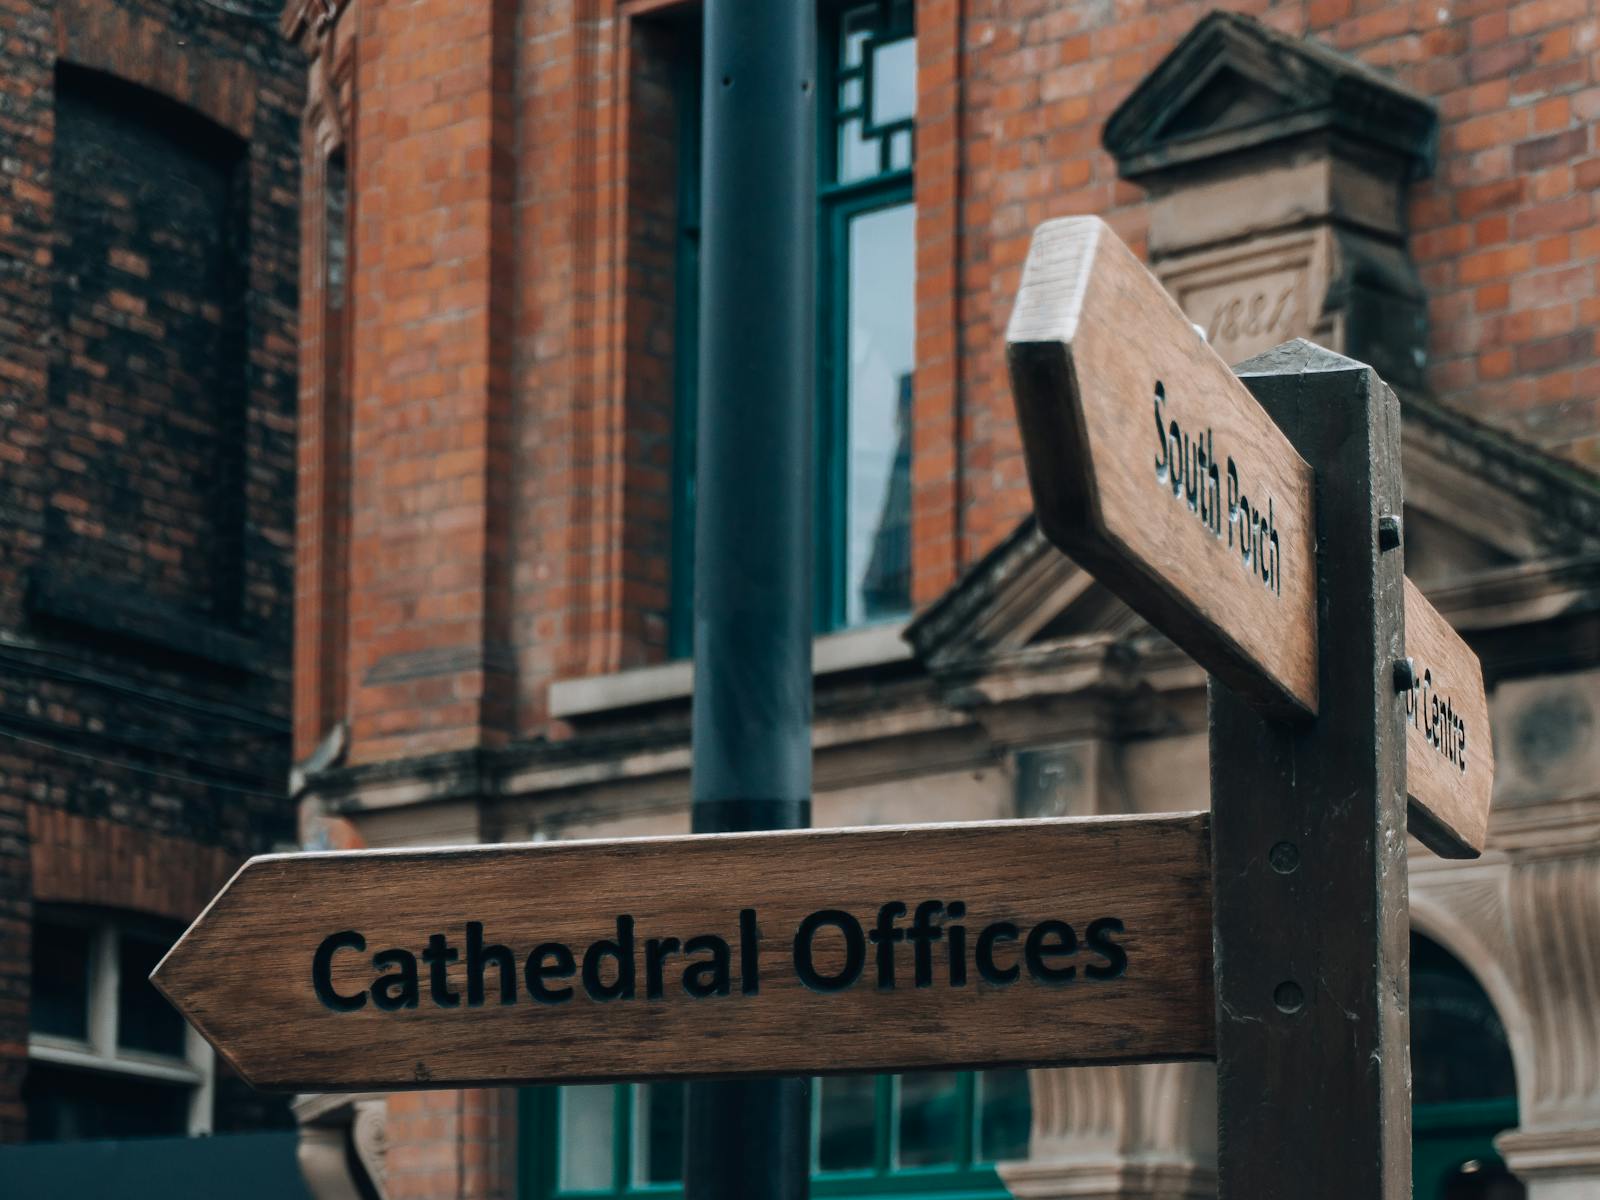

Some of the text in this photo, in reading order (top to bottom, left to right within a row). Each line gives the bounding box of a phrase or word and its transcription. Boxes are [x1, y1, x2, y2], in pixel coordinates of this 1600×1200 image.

[1154, 380, 1281, 599] South Porch
[1423, 668, 1466, 774] Centre
[311, 899, 1129, 1014] Cathedral Offices
